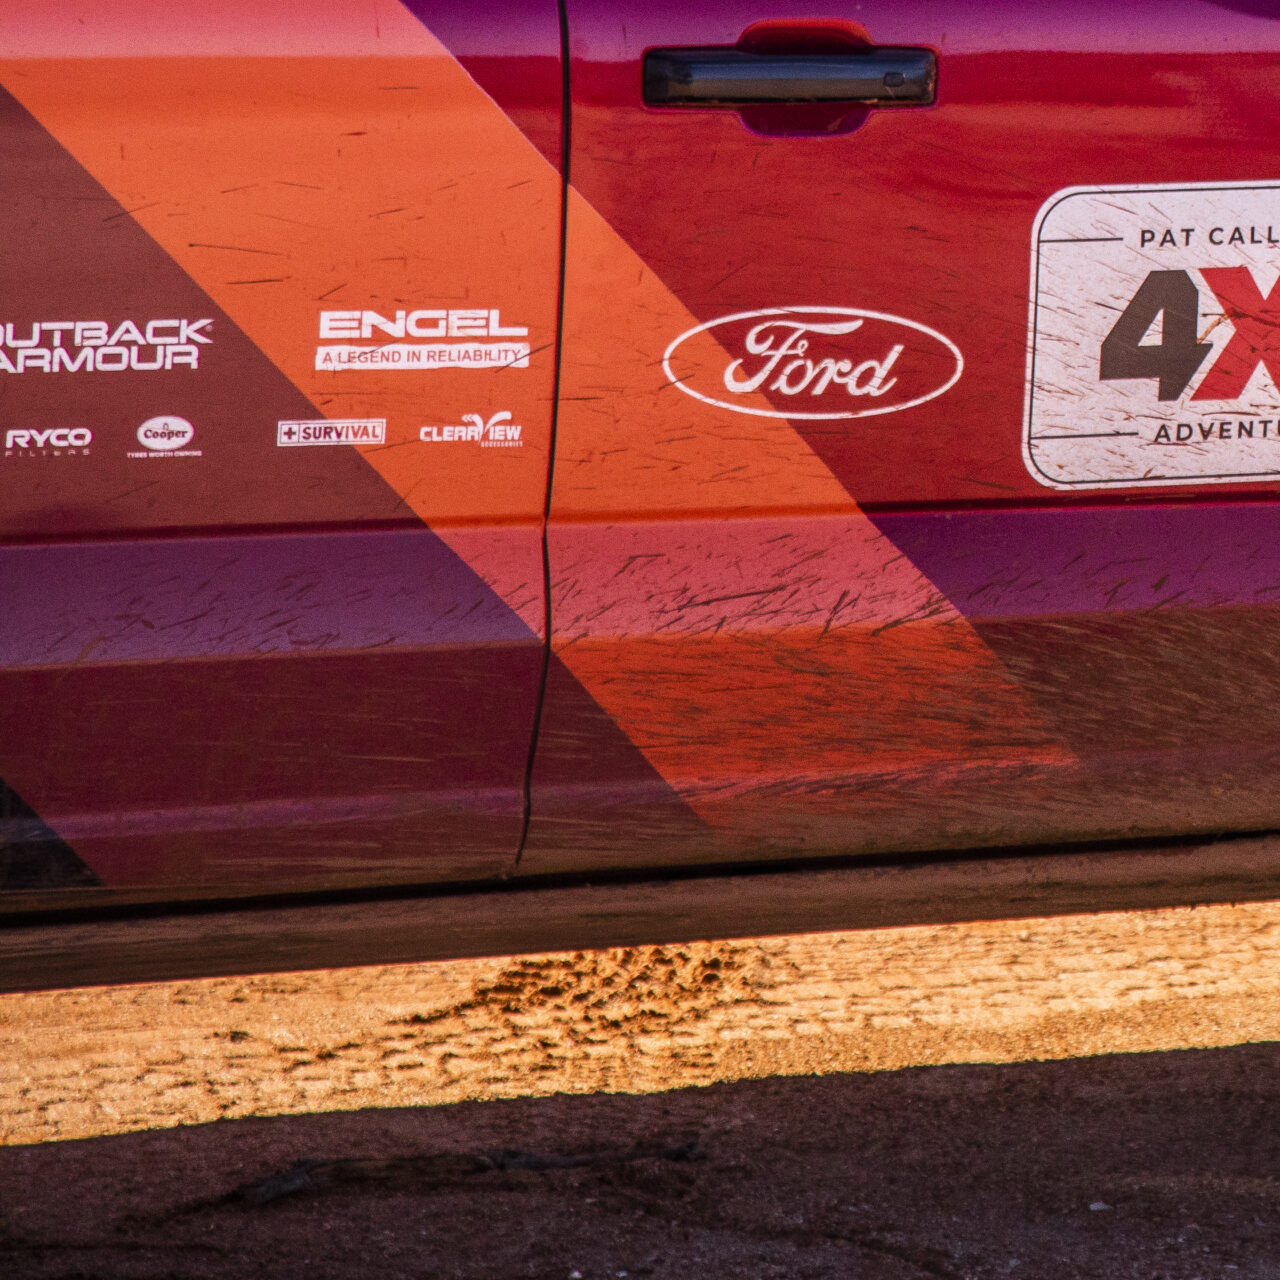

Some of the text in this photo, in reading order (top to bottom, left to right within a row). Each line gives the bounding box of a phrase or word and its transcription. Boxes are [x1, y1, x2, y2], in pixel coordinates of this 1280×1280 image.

[1140, 228, 1195, 248] PAT
[0, 319, 215, 348] UTBACK
[319, 309, 528, 339] ENGEL
[322, 348, 521, 364] A LEGEND IN RELIABILITY
[722, 318, 904, 397] Ford
[144, 429, 188, 440] Cooper
[302, 424, 380, 441] SURVIVAL
[419, 410, 522, 441] CLEARVIEW
[5, 428, 92, 448] RYCO
[5, 448, 91, 457] FILTERS
